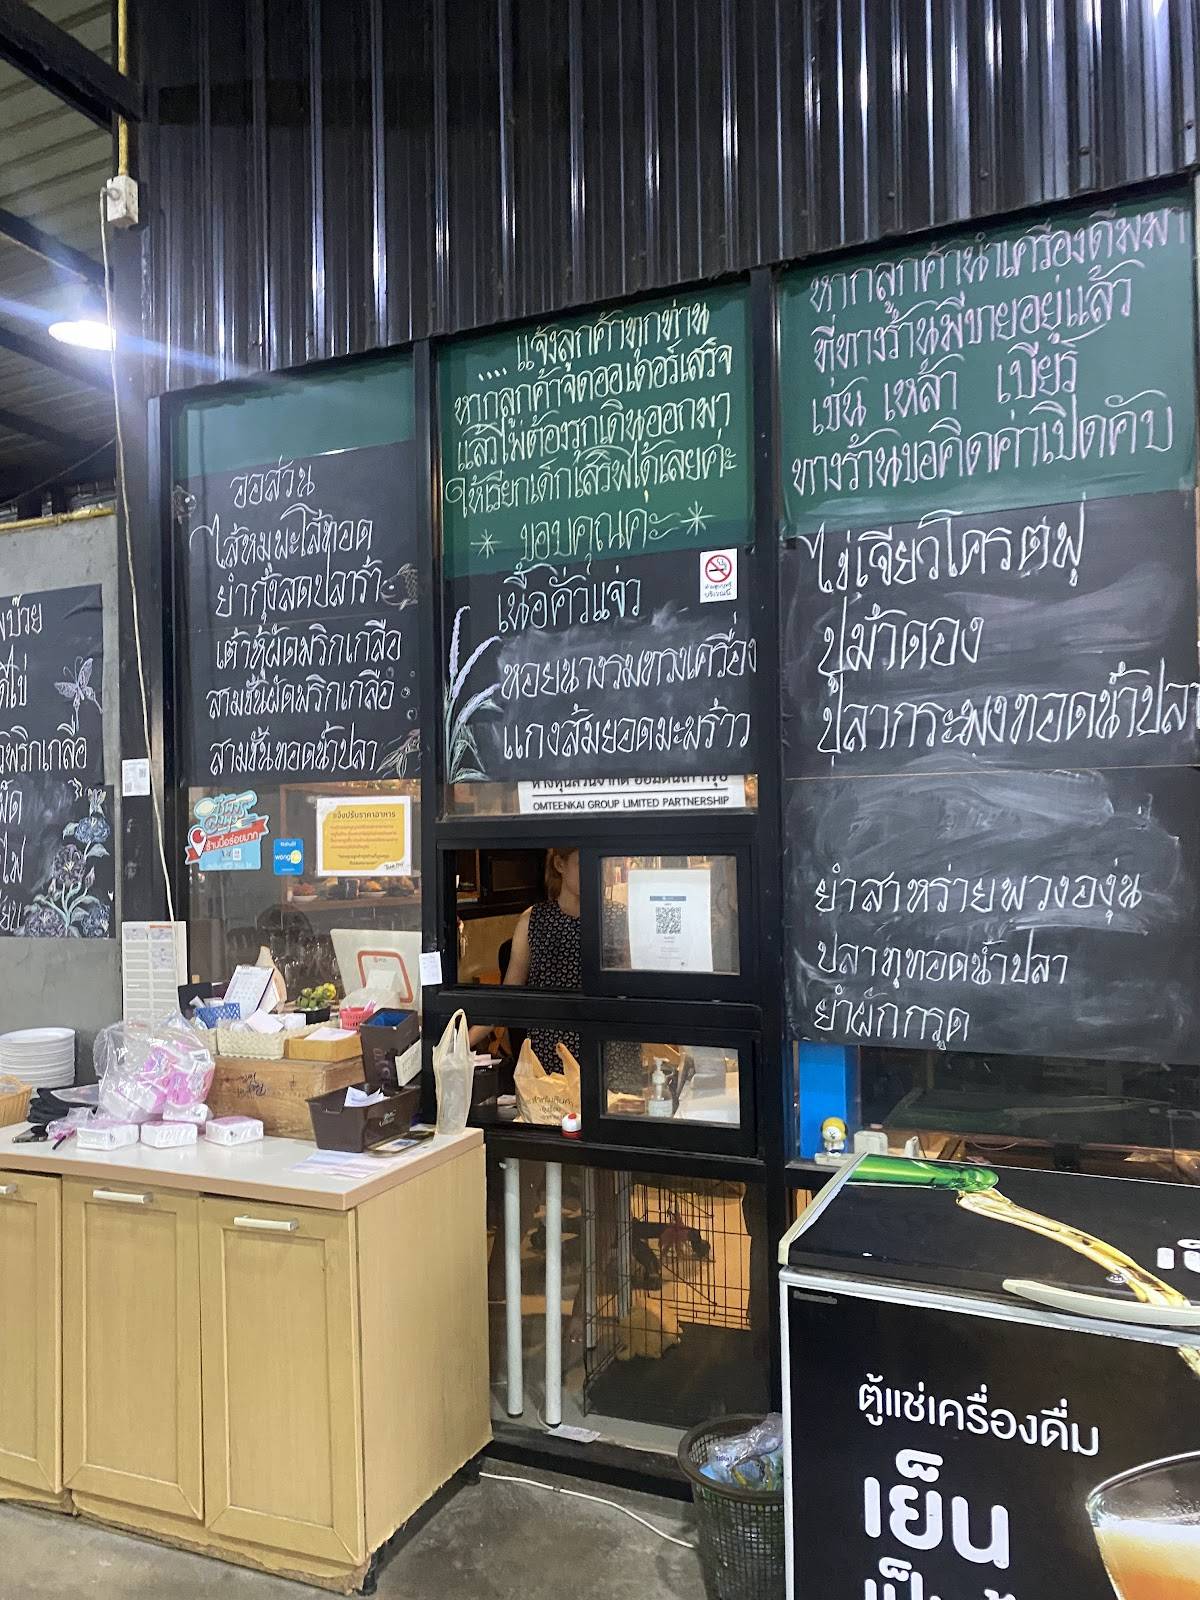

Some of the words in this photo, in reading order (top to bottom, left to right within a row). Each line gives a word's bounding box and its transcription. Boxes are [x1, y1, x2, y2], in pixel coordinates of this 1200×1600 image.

[517, 299, 710, 371] แจ้งลูกค้าทุกท่าน
[811, 259, 1145, 373] ที่ทางร้านมีขายอยู่แล้ว
[812, 376, 868, 435] เช่น
[884, 353, 965, 421] เหล้า
[997, 323, 1106, 404] เบียร์
[791, 389, 1173, 496] ทางร้านขอคิดค่าเปิดคับ
[216, 619, 401, 680] เต้าหู้ผัดพริกเกลือ
[501, 612, 757, 700] หอยนางรมทรงเครื่อง
[817, 596, 985, 696] ปูม้าดอง
[206, 669, 395, 719] สามชั้นผัดพริกเกลือ
[504, 697, 751, 760] แกงส้มยอดมะพร้าว
[210, 720, 378, 776] สามชั้นทอดน้ำปลา
[533, 801, 585, 811] OMTEENKAI
[587, 799, 620, 810] GROUP
[623, 797, 660, 808] LIMITED
[662, 795, 729, 807] PARTNERSHIP
[814, 858, 1143, 925] ยำสาหร่ายพวงองุ่น
[817, 928, 1069, 989] ปลาทูทอดน้ำปลา
[858, 1373, 1099, 1456] ตู้แช่เครื่องดื่ม
[864, 1448, 1010, 1569] เย็น
